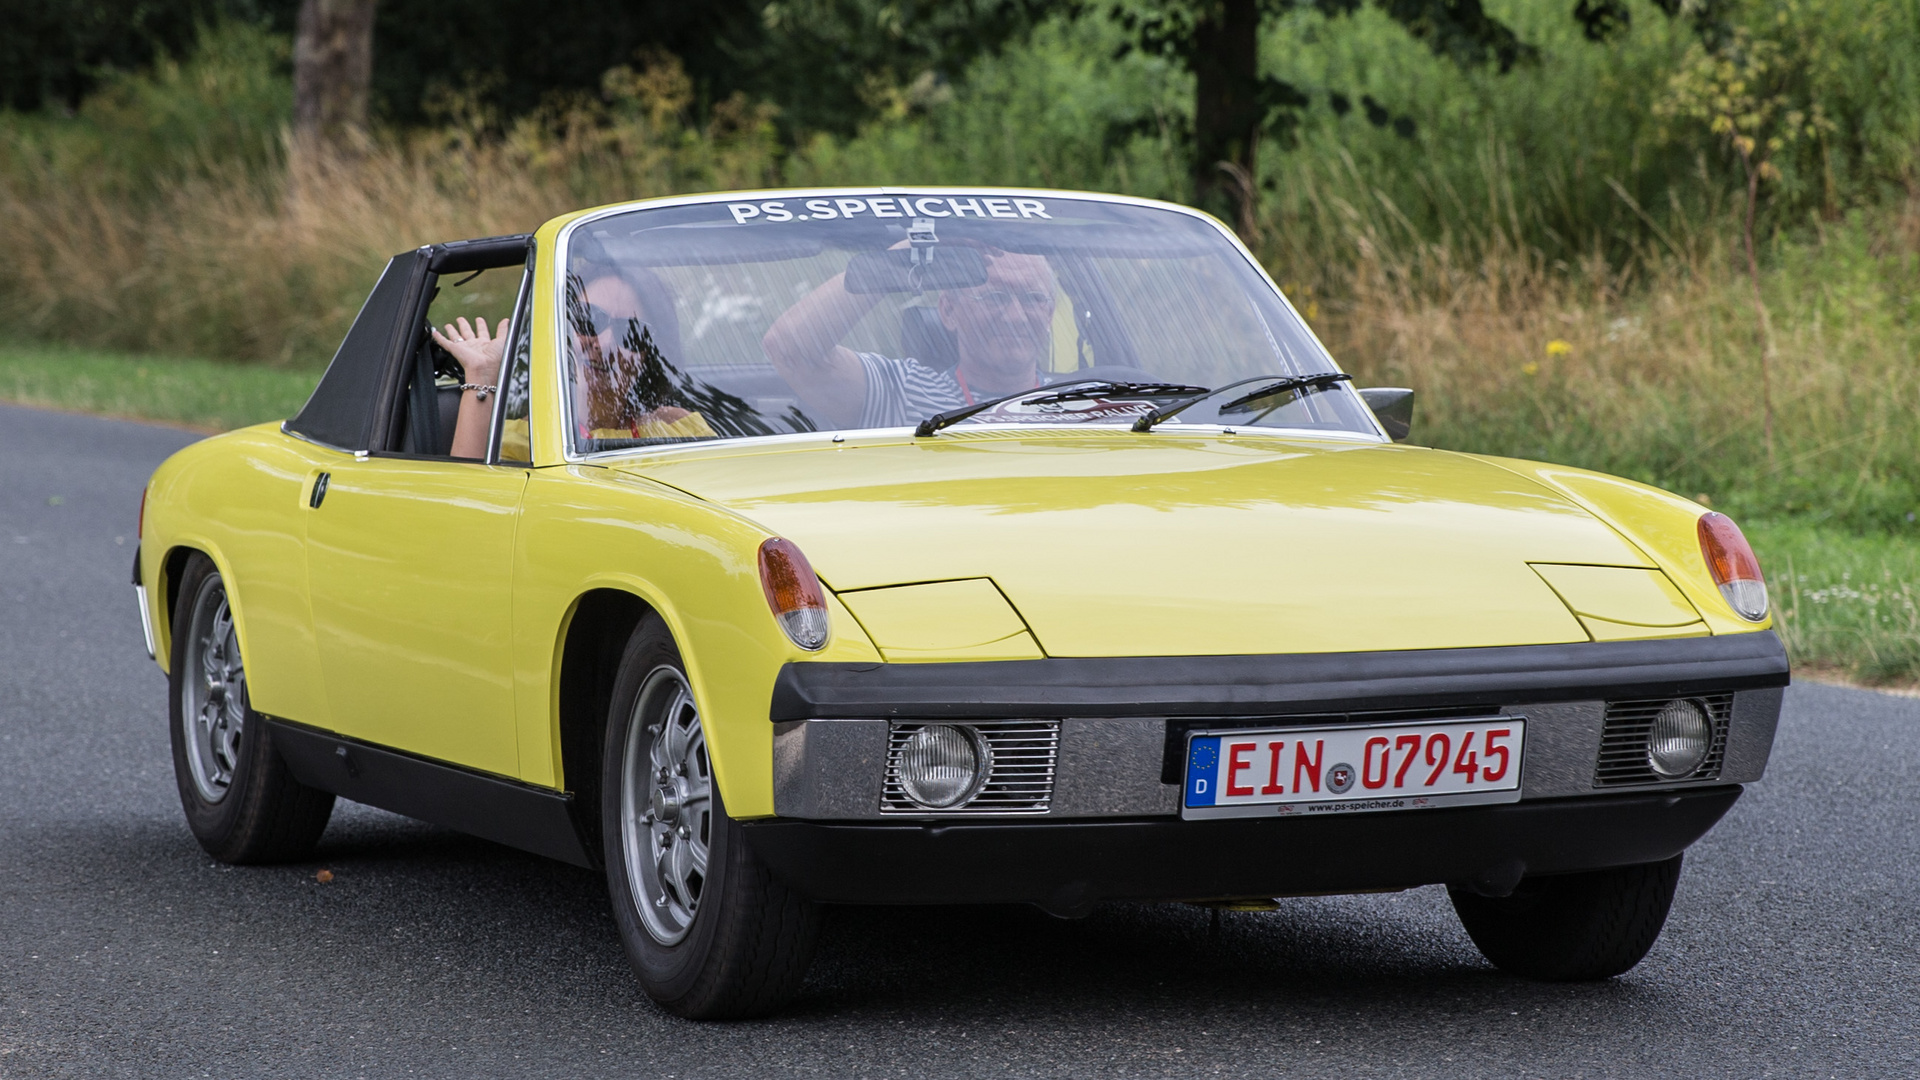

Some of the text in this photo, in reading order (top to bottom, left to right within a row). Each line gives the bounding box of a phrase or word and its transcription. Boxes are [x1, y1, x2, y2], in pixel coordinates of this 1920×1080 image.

[727, 197, 1052, 224] PS.SPEICHER
[1090, 404, 1153, 418] RALLYE
[1226, 729, 1511, 797] EIN 07945
[1195, 779, 1208, 794] D
[1308, 799, 1405, 813] www.ps-speicher.de
